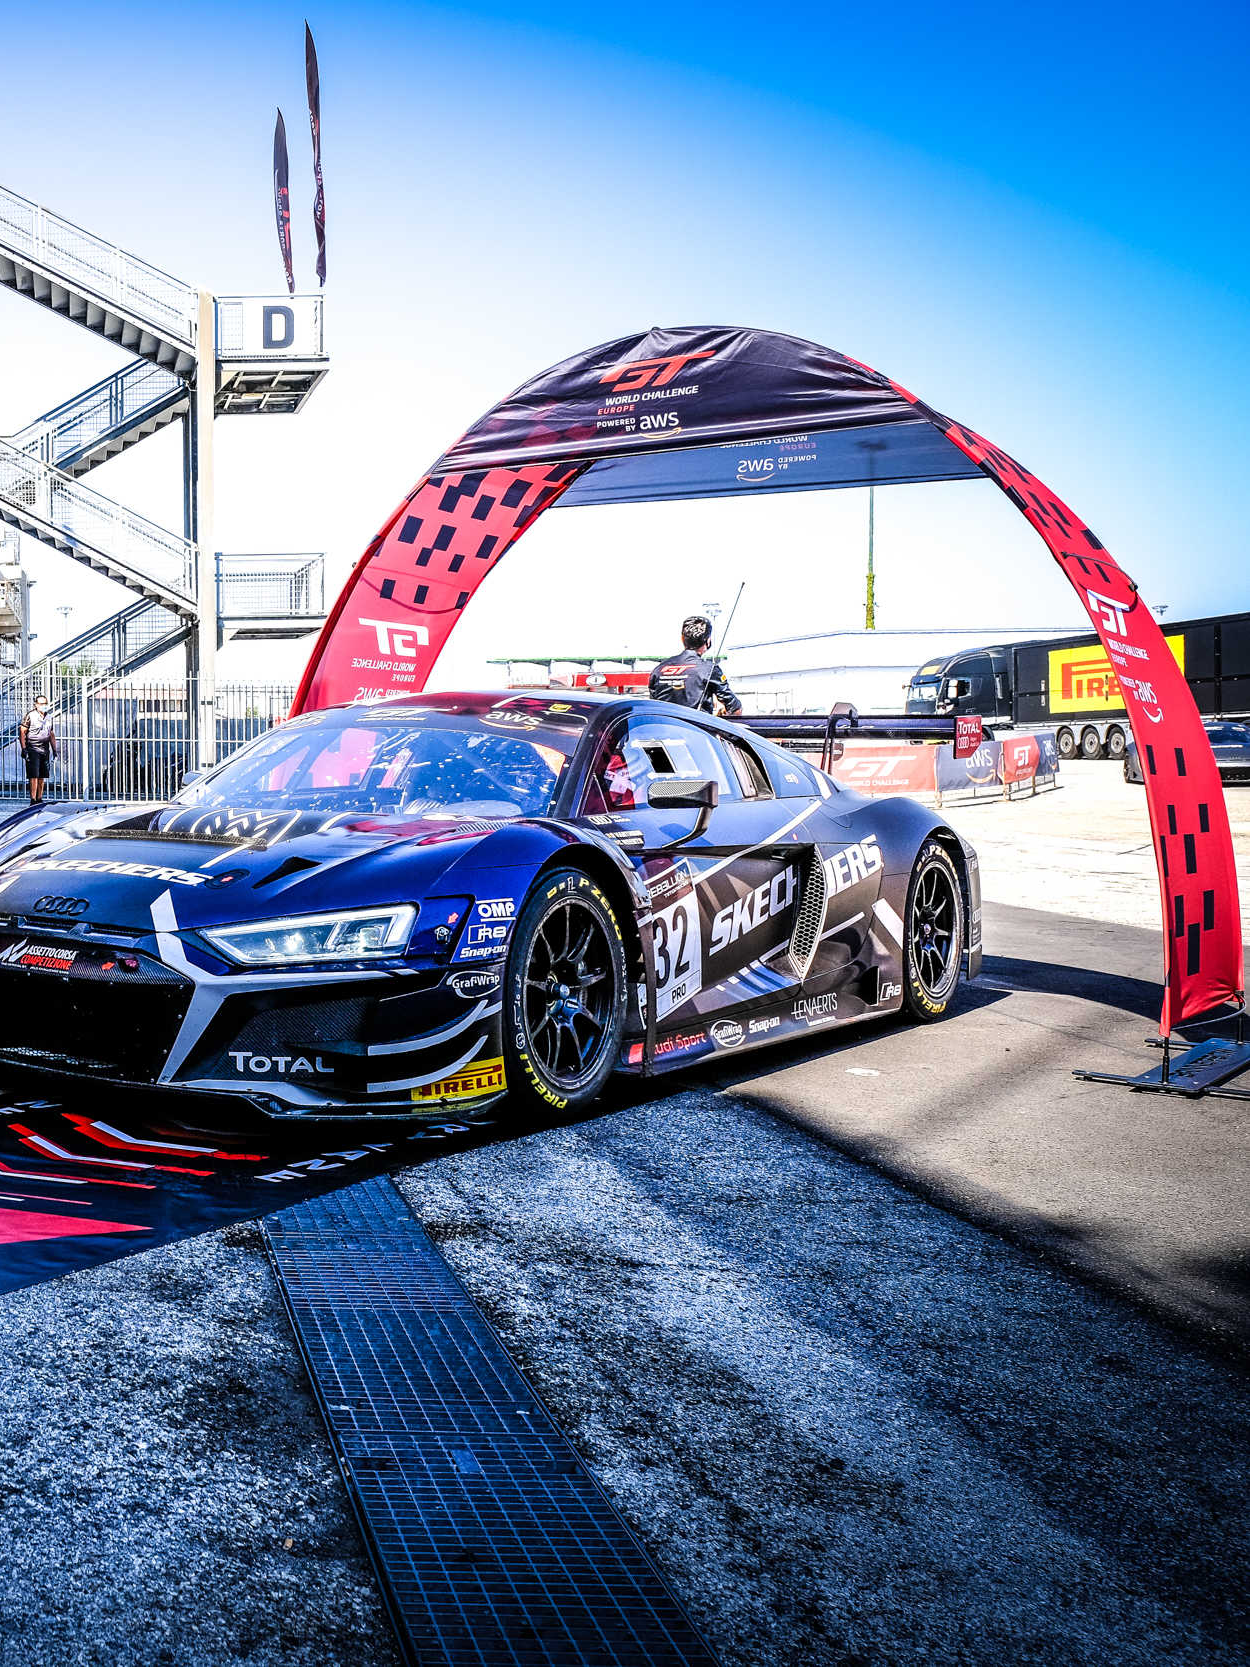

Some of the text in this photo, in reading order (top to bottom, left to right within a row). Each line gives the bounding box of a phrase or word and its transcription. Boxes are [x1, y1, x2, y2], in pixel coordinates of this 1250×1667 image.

[262, 305, 295, 349] D
[599, 350, 716, 392] GT
[605, 385, 699, 406] WORLD CHALLENGE
[597, 404, 635, 415] EUROPE
[596, 418, 636, 429] POWERED
[639, 412, 680, 430] aws
[1087, 588, 1130, 637] GT
[485, 708, 545, 726] aws
[957, 721, 981, 734] TOTAL
[838, 755, 917, 777] GT
[16, 859, 214, 887] SKECHERS
[477, 902, 516, 918] OMP
[477, 926, 507, 942] R8
[26, 944, 77, 961] ASSETTO CORSA
[459, 944, 510, 959] Snap-on
[652, 905, 690, 990] 32
[20, 954, 75, 971] COMPETIZIONE
[452, 973, 500, 990] GrafiWrap
[670, 988, 687, 1004] PRO
[790, 992, 839, 1021] LENAERTS
[655, 1037, 675, 1055] udi
[674, 1032, 707, 1051] Sport
[228, 1051, 335, 1074] TOTAL
[519, 1053, 569, 1110] PIRELLI
